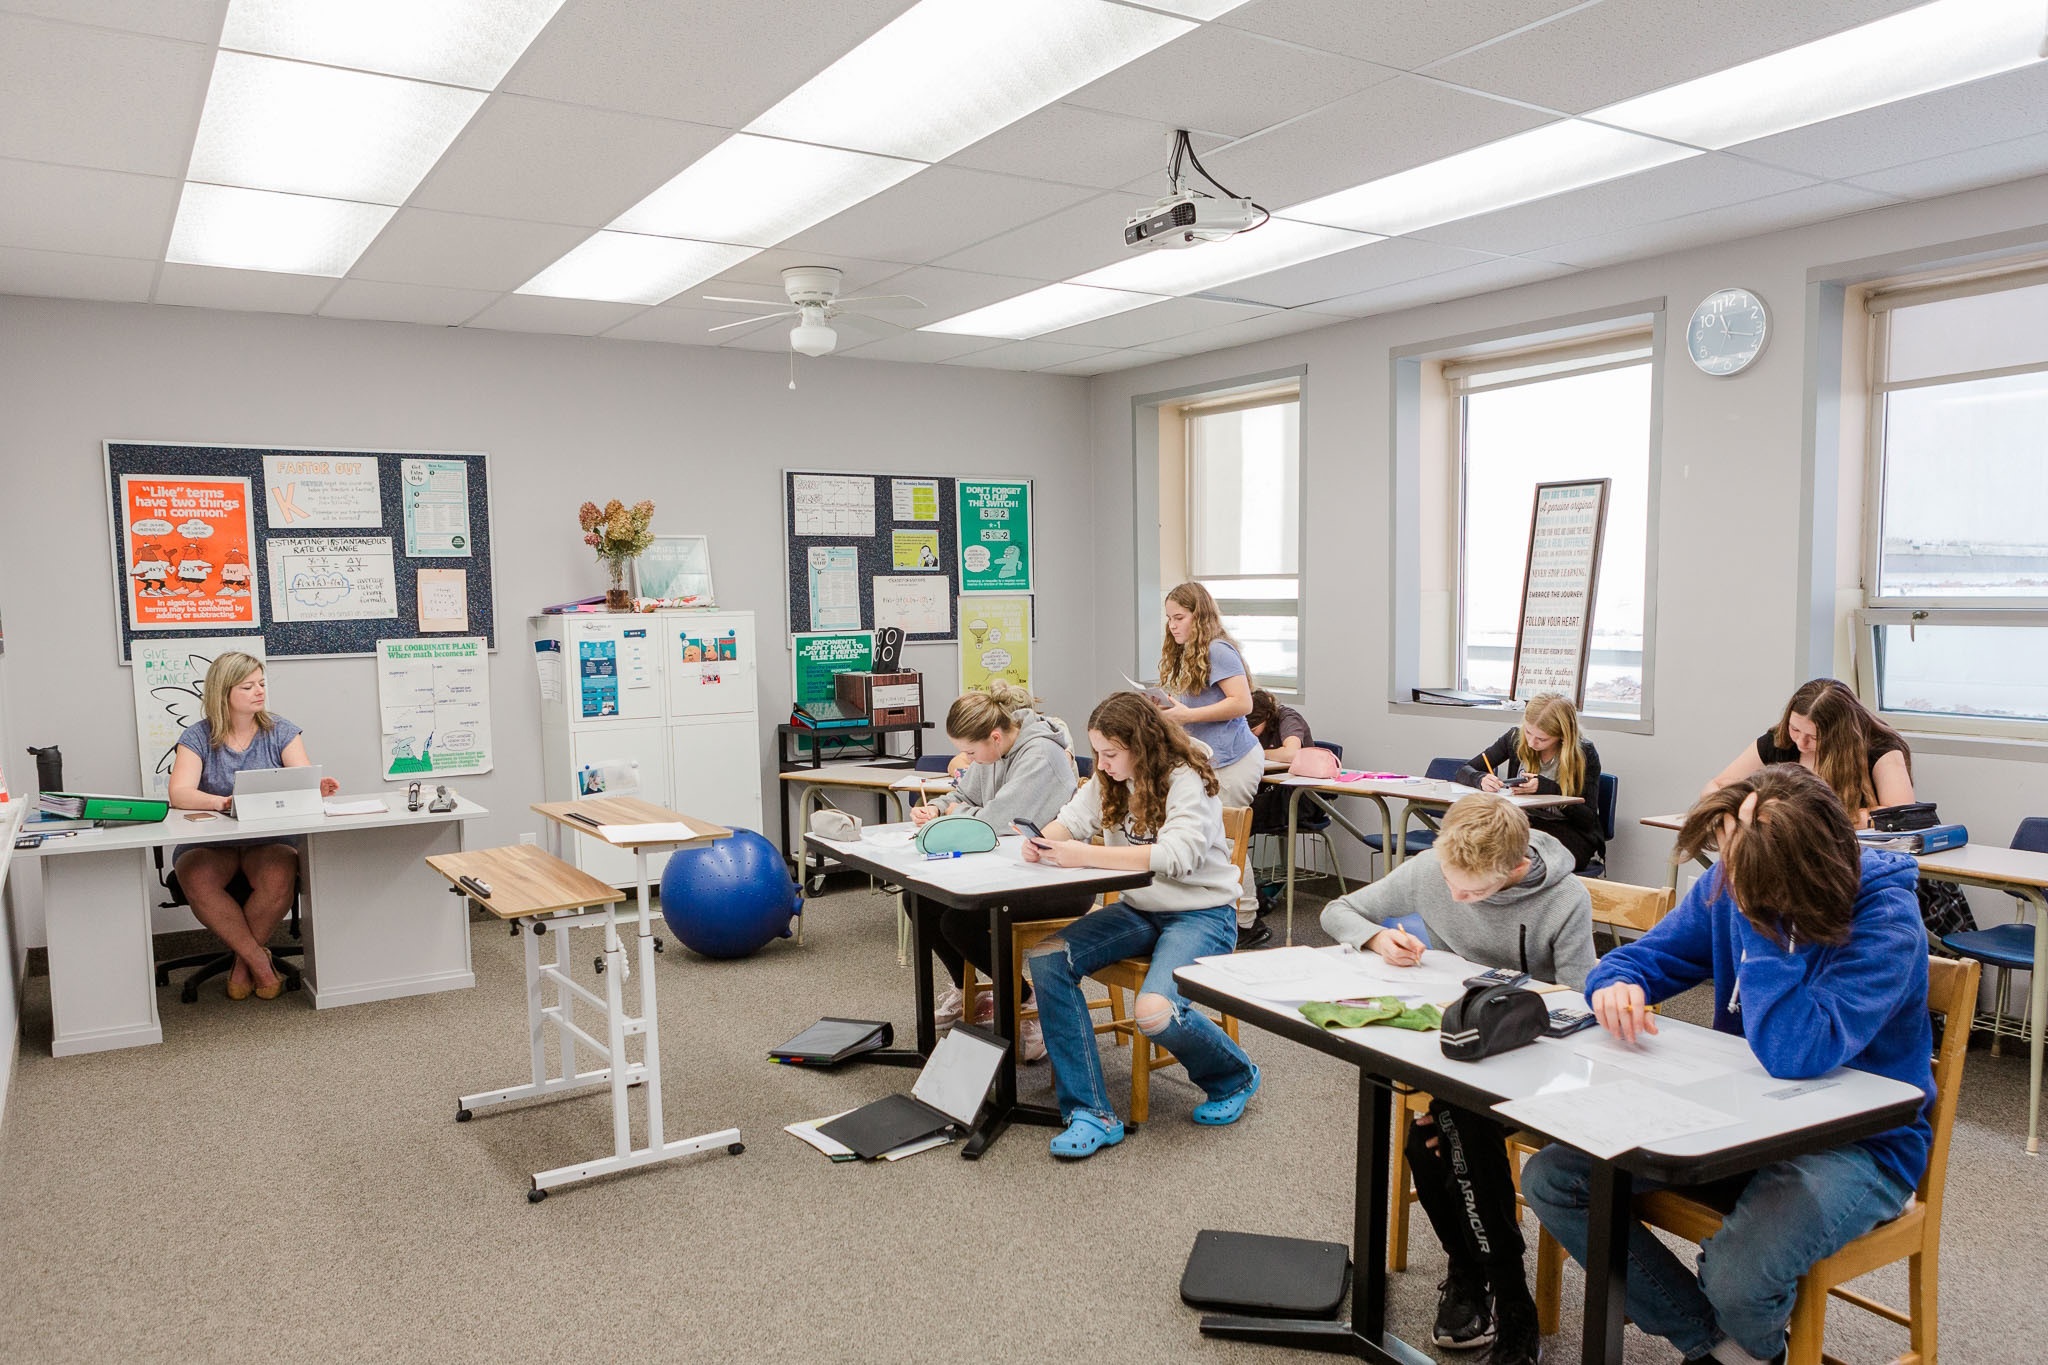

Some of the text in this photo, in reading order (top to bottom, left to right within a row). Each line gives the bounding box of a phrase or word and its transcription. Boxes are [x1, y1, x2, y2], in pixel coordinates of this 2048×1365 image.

[1712, 299, 1723, 313] 11
[1723, 294, 1736, 307] 12
[1741, 295, 1748, 308] 1
[1750, 305, 1759, 320] 2
[1700, 313, 1715, 328] 10
[277, 461, 362, 475] FACTOR OUT
[186, 487, 225, 499] terms
[966, 486, 990, 494] DON'T
[135, 496, 240, 511] have two things
[271, 482, 311, 524] K
[154, 508, 228, 518] in common.
[984, 510, 1006, 518] 5 2
[268, 538, 388, 548] ESTIMATING INSTANTANEOUS
[293, 546, 314, 554] RATE
[198, 599, 214, 607] only
[235, 604, 244, 612] by
[156, 612, 182, 620] adding
[1526, 616, 1546, 626] FOLLOW
[1547, 616, 1560, 626] YOUR
[386, 642, 478, 652] THE COORDINATE PLANE:
[812, 638, 857, 646] EXPONENTS
[143, 648, 169, 660] GIVE
[388, 651, 412, 659] Where
[434, 650, 463, 658] becomes
[145, 660, 191, 673] PEACE A
[1520, 666, 1532, 677] You
[1544, 666, 1553, 674] the
[1554, 667, 1574, 676] author
[146, 672, 190, 686] CHANCE
[1438, 1110, 1491, 1254] UNDER ARMOUR
